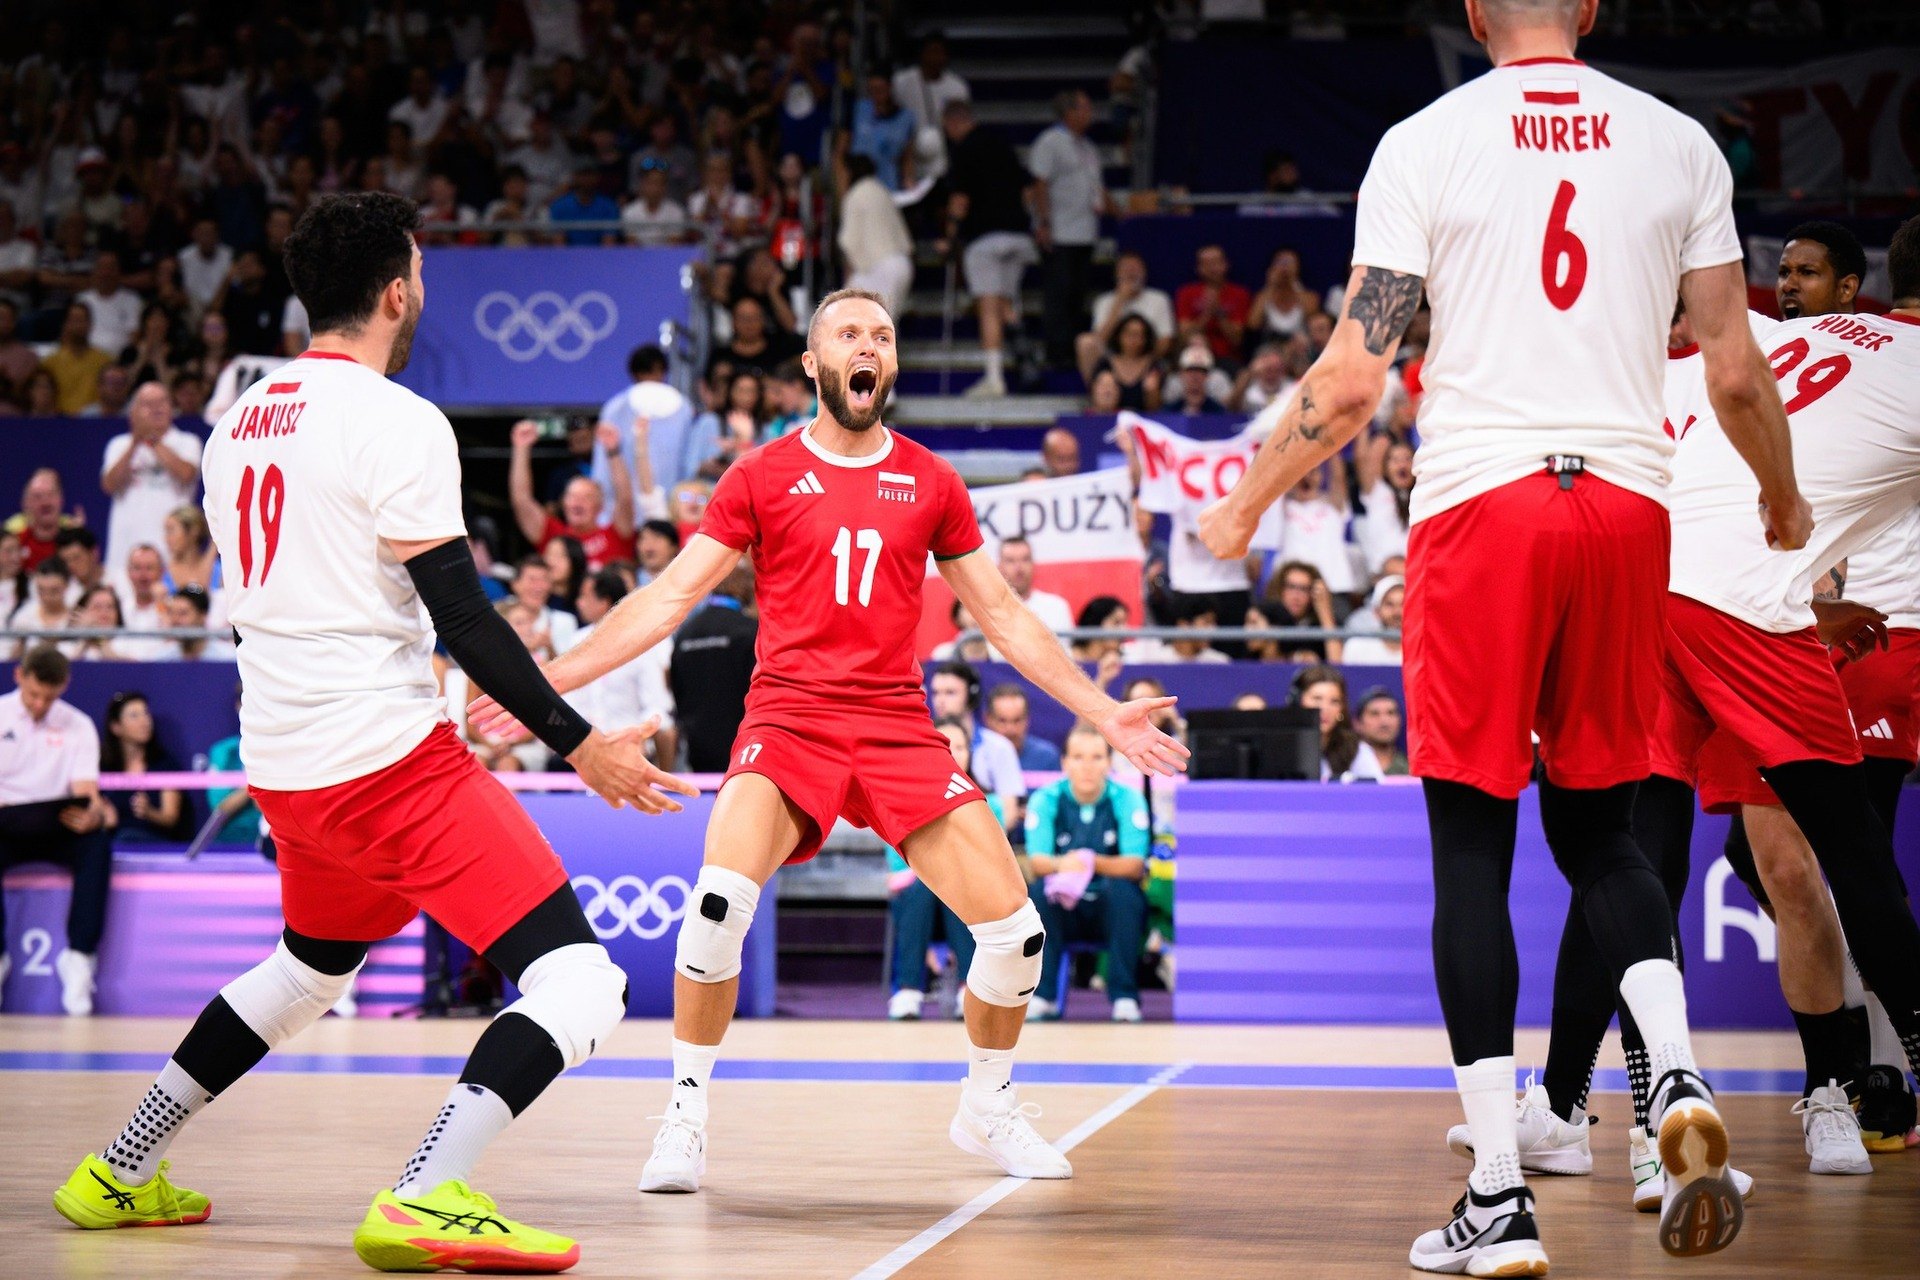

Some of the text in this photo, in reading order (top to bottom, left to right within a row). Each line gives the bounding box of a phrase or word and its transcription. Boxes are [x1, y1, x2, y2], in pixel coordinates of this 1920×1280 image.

[1511, 112, 1611, 153] KUREK
[1541, 180, 1588, 311] 6
[1812, 315, 1894, 352] HUBER
[231, 401, 307, 441] JANUSZ
[877, 489, 916, 504] POLSKA
[236, 463, 285, 588] 19
[830, 526, 884, 608] 17
[740, 743, 763, 765] 17
[22, 927, 53, 976] 2
